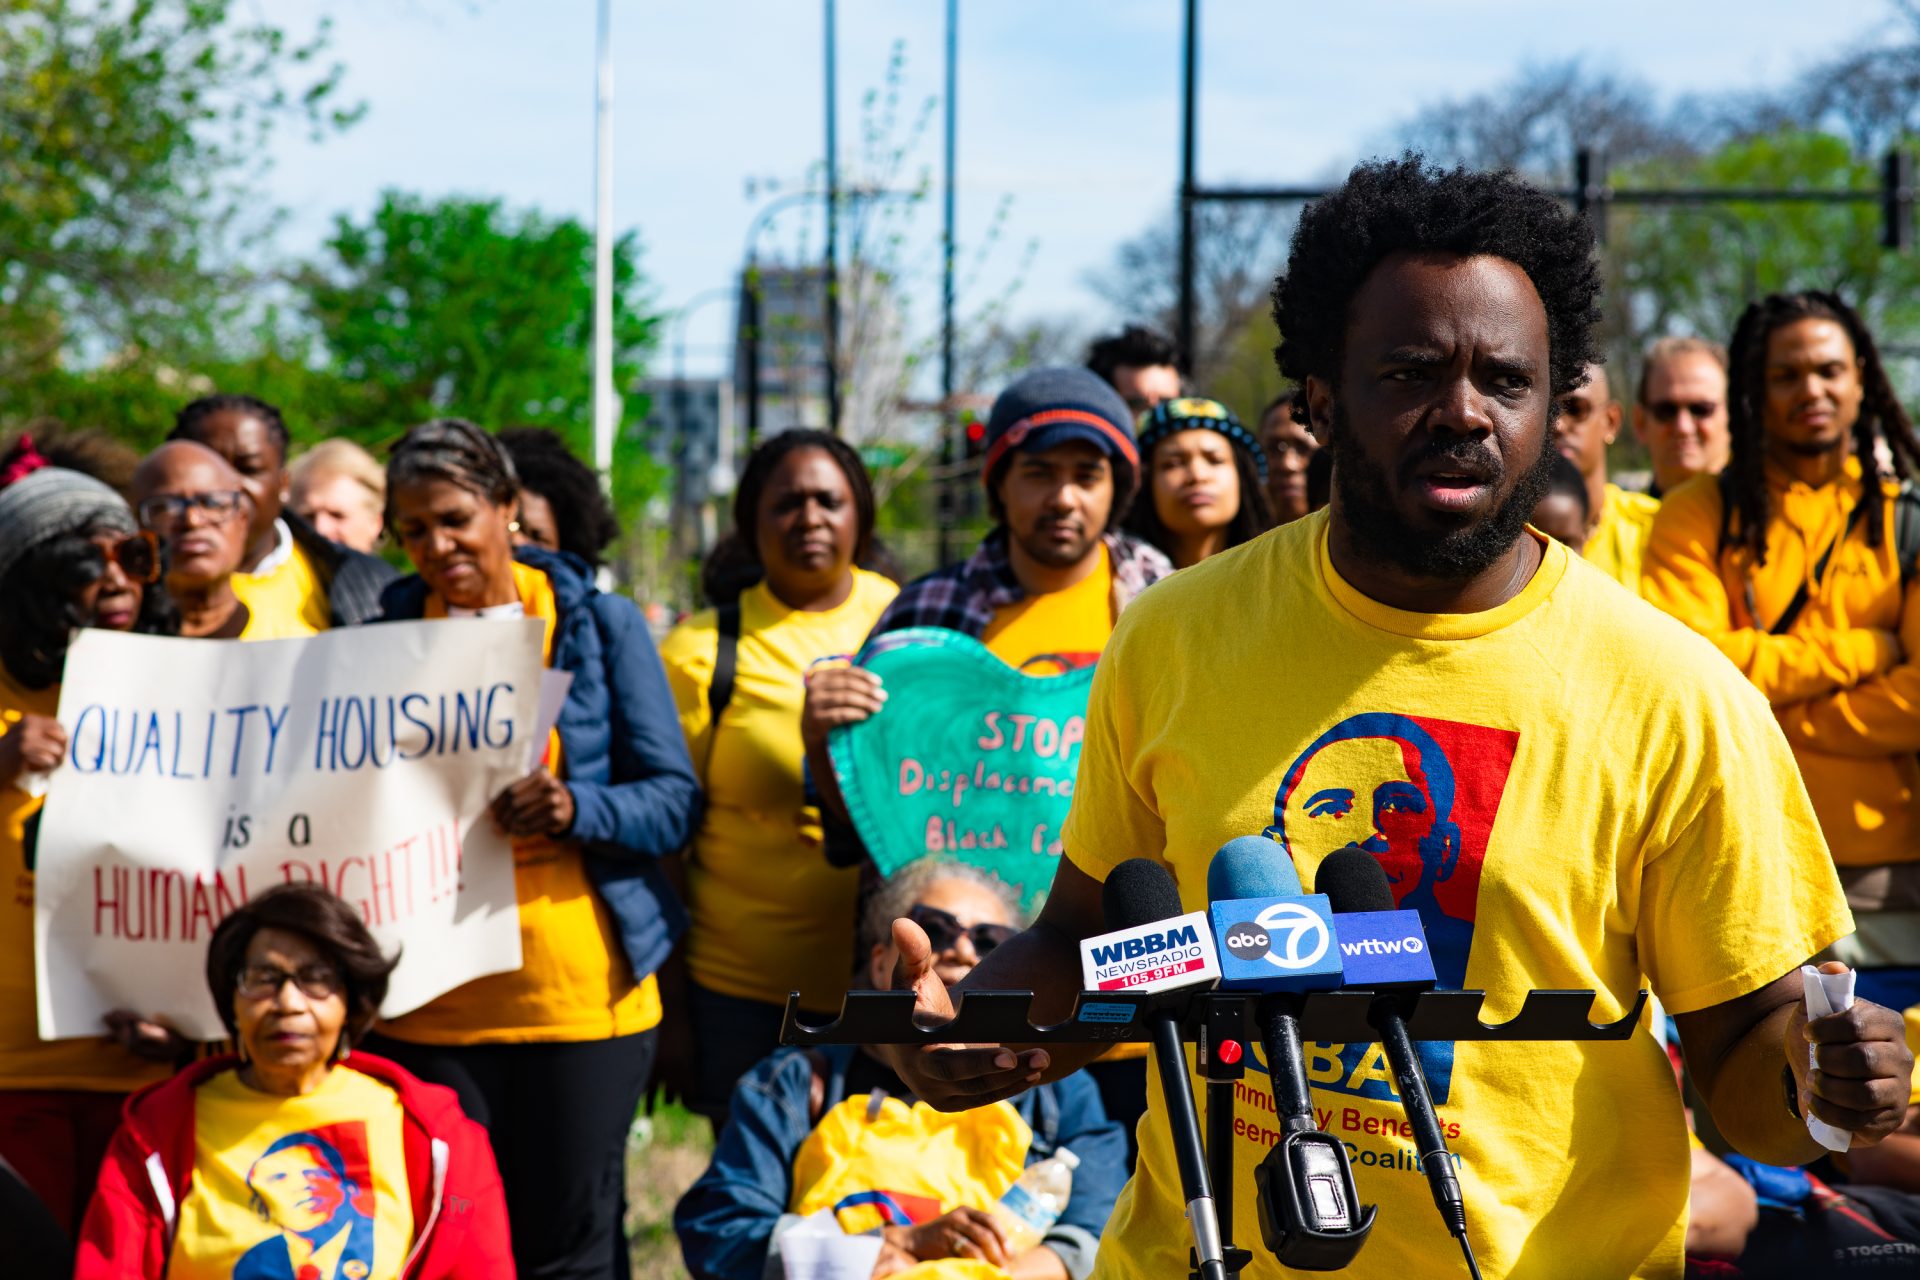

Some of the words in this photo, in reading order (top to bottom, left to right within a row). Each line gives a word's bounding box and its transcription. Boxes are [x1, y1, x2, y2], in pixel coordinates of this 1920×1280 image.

[71, 704, 290, 779] QUALITY
[315, 683, 515, 770] HOUSING
[977, 711, 1086, 761] STOP
[222, 805, 252, 849] is
[288, 813, 311, 847] a
[925, 816, 1008, 851] Black
[1090, 925, 1199, 967] WBBM
[1227, 932, 1269, 948] abc
[1257, 904, 1329, 968] 7
[1340, 938, 1401, 956] wttw
[1096, 946, 1202, 980] NEWSRADIO
[1121, 962, 1187, 988] 105.9FM
